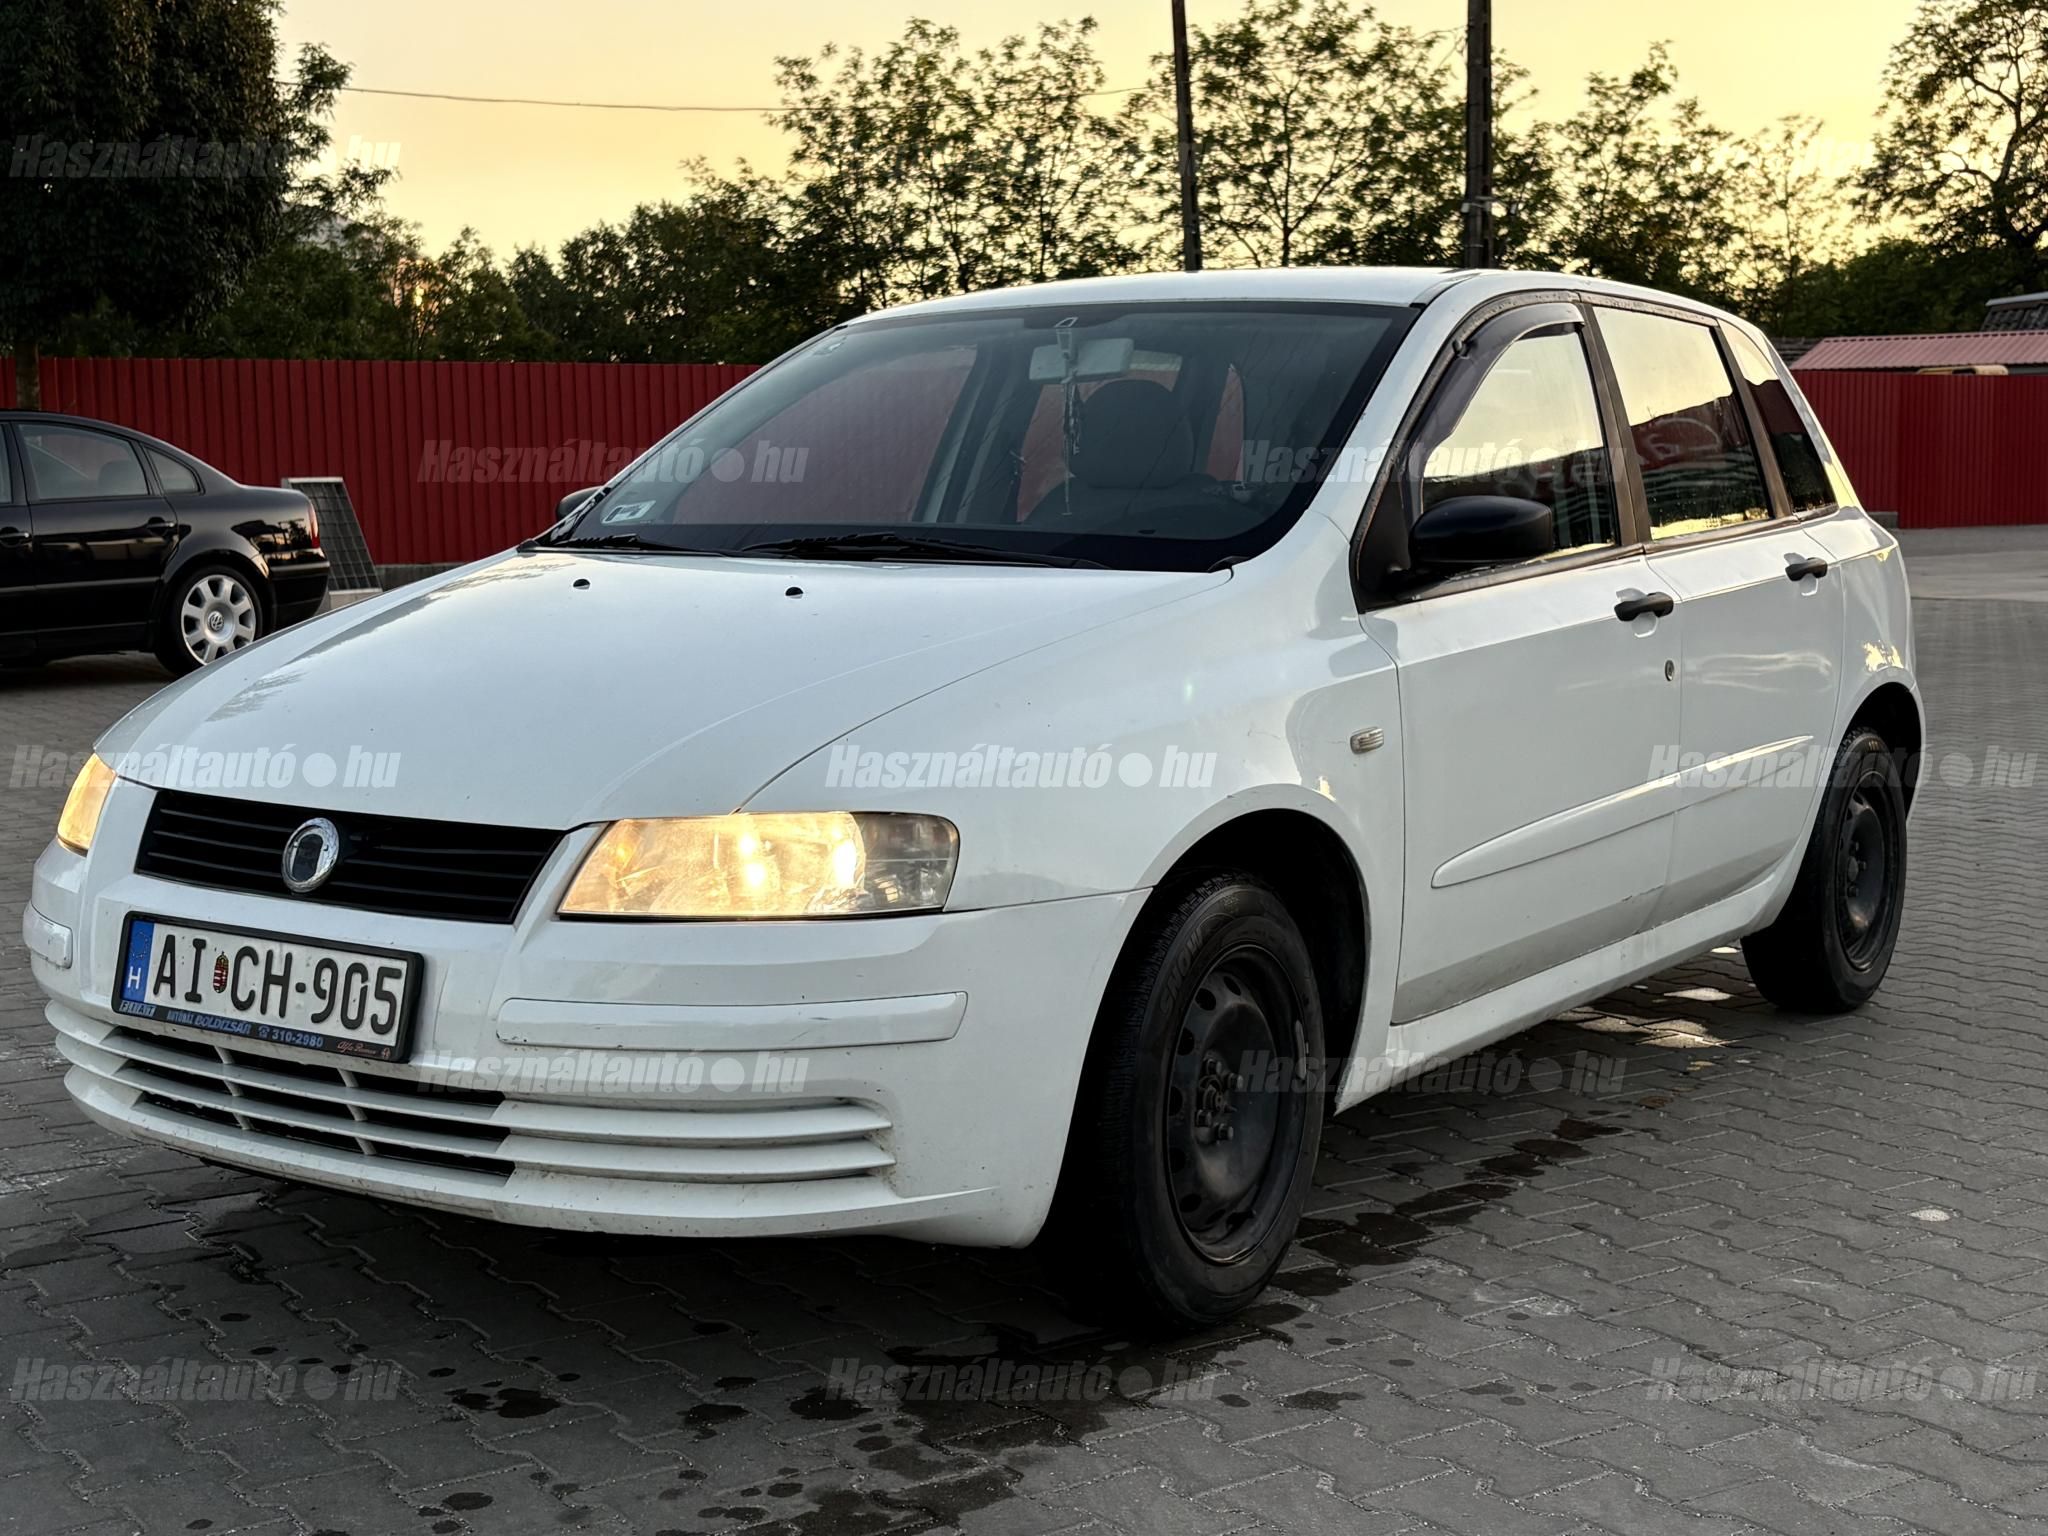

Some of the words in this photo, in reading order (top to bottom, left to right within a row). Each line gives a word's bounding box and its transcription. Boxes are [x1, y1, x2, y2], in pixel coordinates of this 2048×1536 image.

[127, 967, 142, 990] H
[230, 946, 402, 1035] CH-905
[272, 1029, 325, 1048] 310-2980
